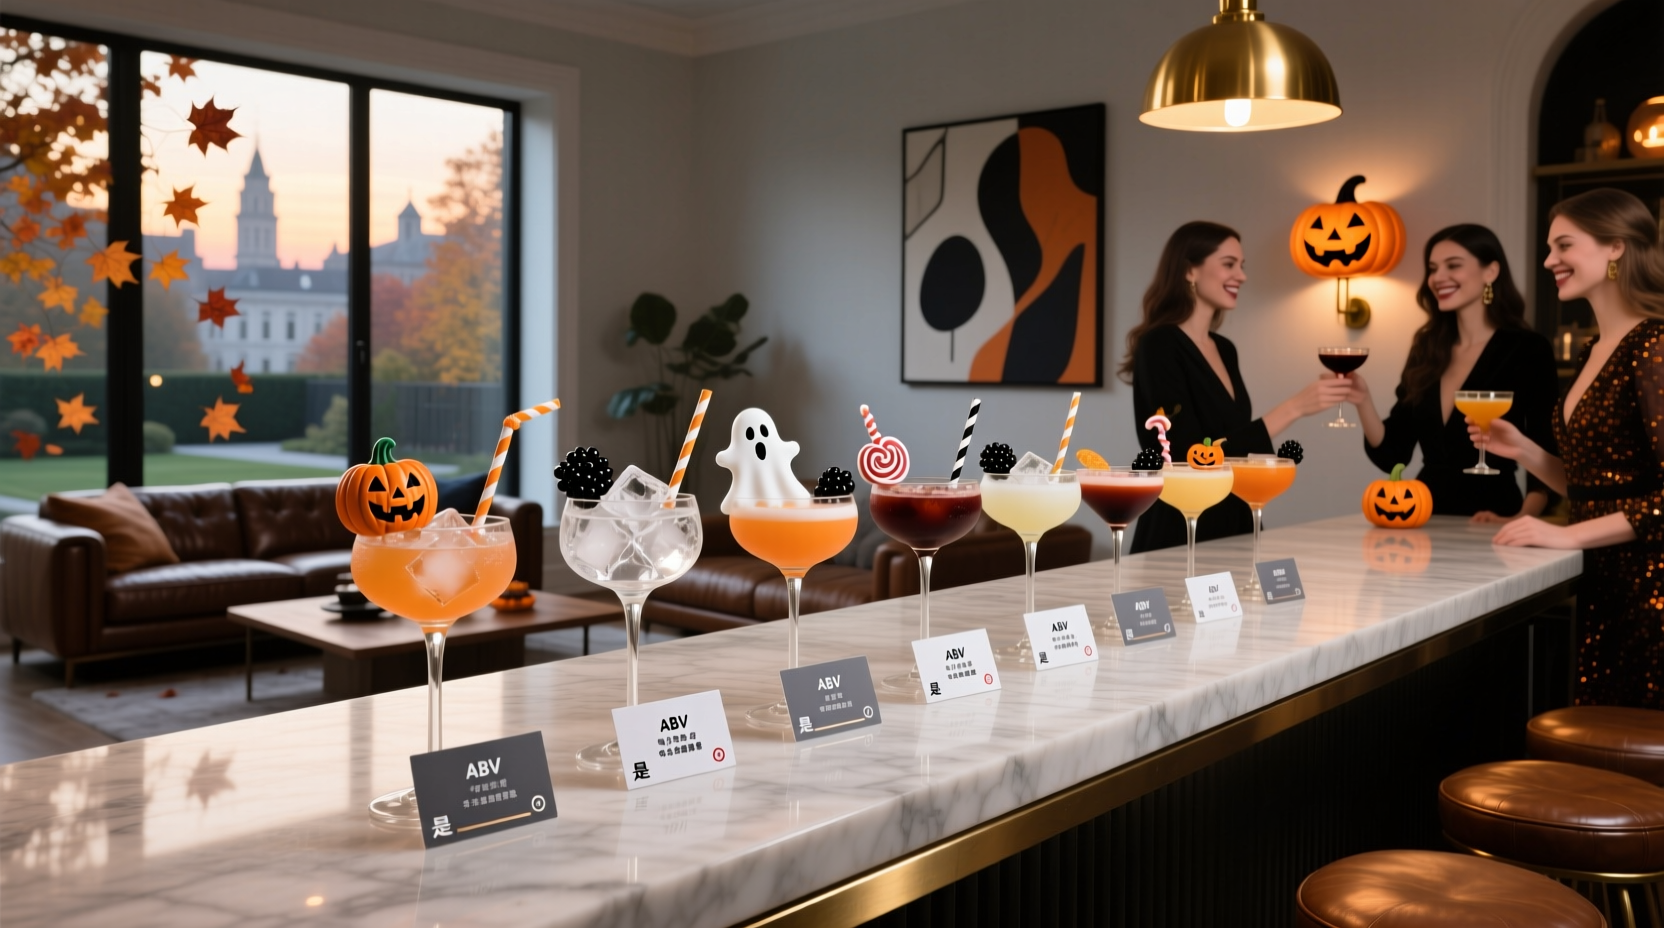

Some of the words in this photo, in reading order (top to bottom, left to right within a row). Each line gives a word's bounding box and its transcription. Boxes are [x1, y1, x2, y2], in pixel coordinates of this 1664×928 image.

[945, 646, 965, 661] ABV
[818, 674, 840, 691] ABV
[660, 714, 688, 732] ABV
[466, 757, 501, 780] ABV
[632, 761, 650, 781] 是
[432, 815, 453, 838] 是
